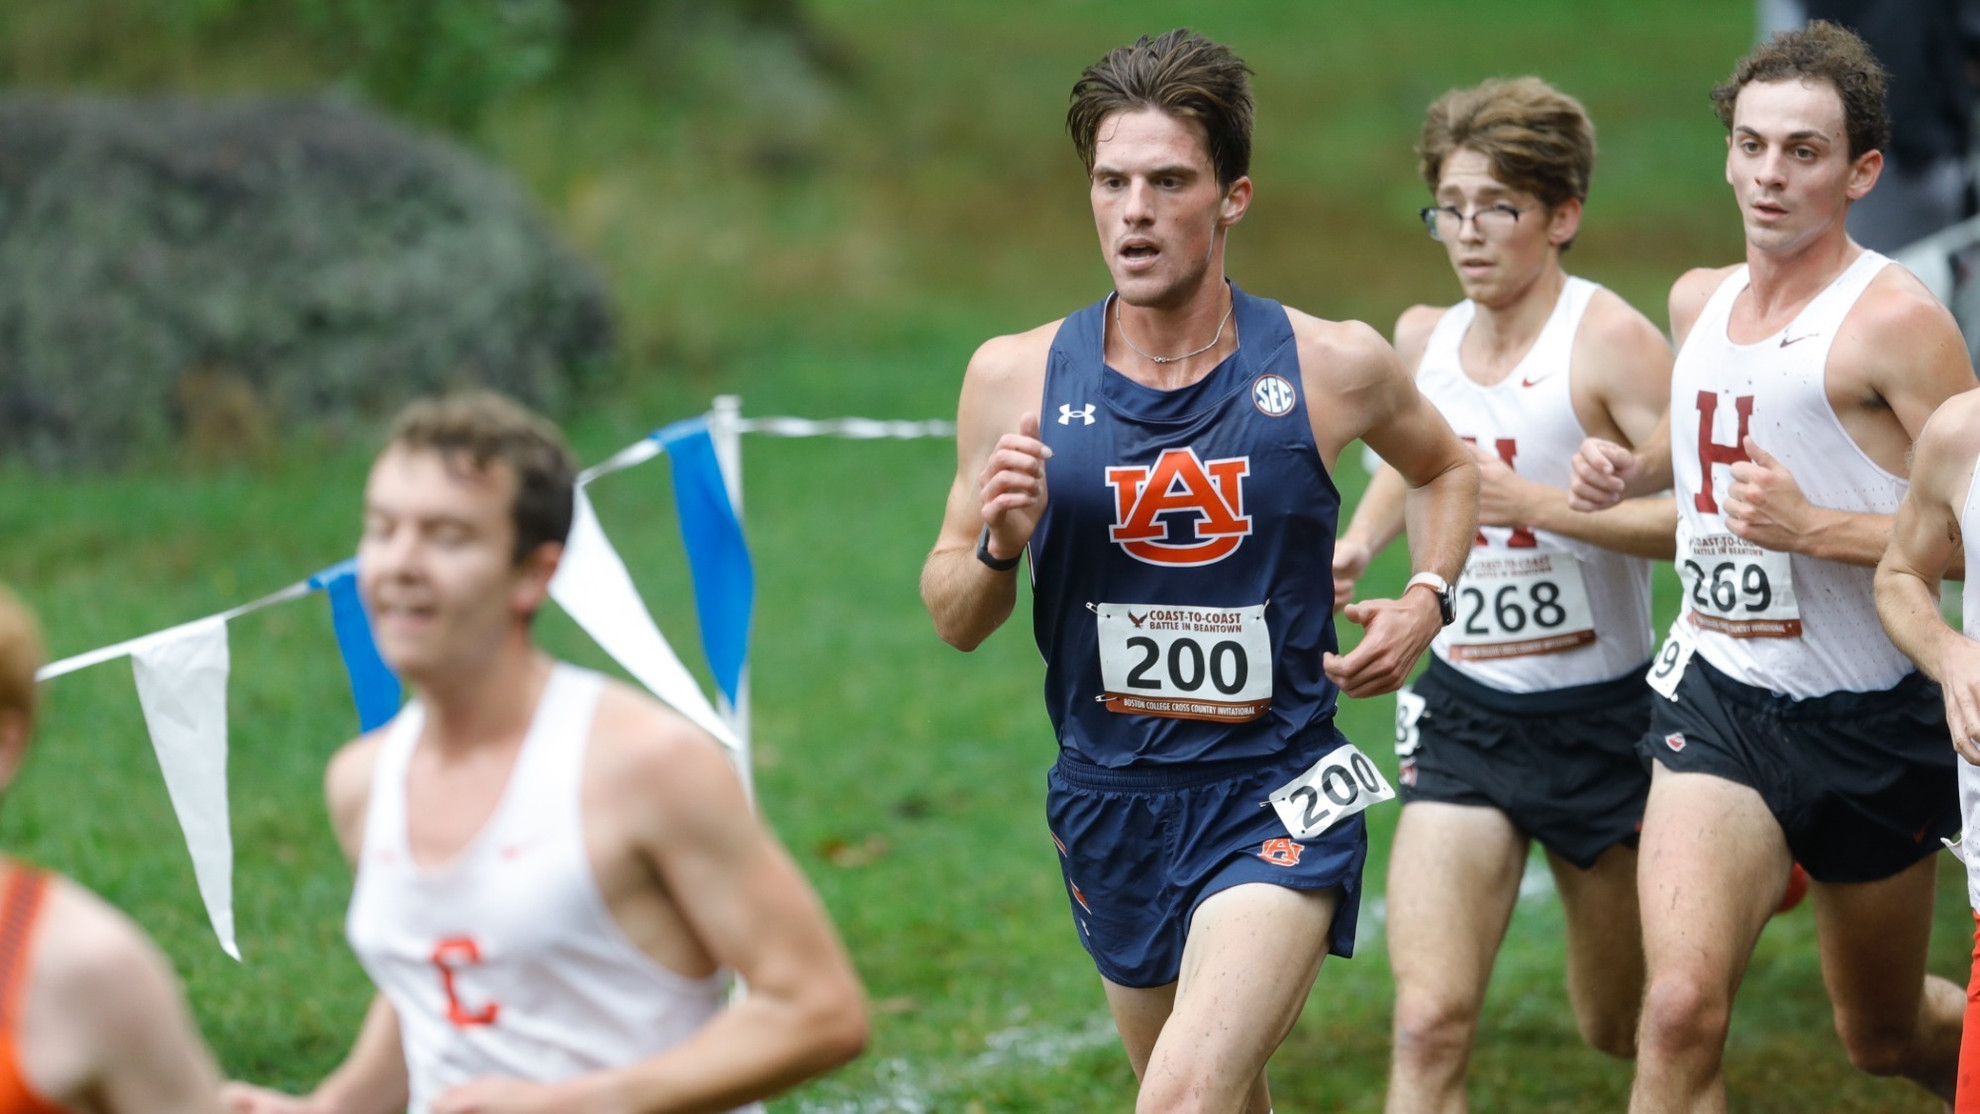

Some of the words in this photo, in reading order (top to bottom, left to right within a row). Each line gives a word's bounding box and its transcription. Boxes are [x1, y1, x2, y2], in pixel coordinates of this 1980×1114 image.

[1255, 378, 1292, 413] SEC
[1694, 390, 1755, 515] H
[1461, 581, 1567, 635] 268
[1684, 558, 1772, 613] 269
[1149, 610, 1242, 624] COAST-TO-COAST
[1149, 621, 1179, 630] BATTLE
[1181, 622, 1191, 631] IN
[1194, 623, 1242, 633] BEANTOWN
[1125, 636, 1249, 695] 200
[1123, 698, 1145, 709] BOSTON
[1146, 701, 1171, 711] COLLEGE
[1172, 703, 1190, 712] CROSS
[1191, 704, 1216, 715] COUNTRY
[1217, 706, 1256, 716] INVITATIONAL
[1289, 752, 1381, 830] 200
[431, 933, 500, 1032] C
